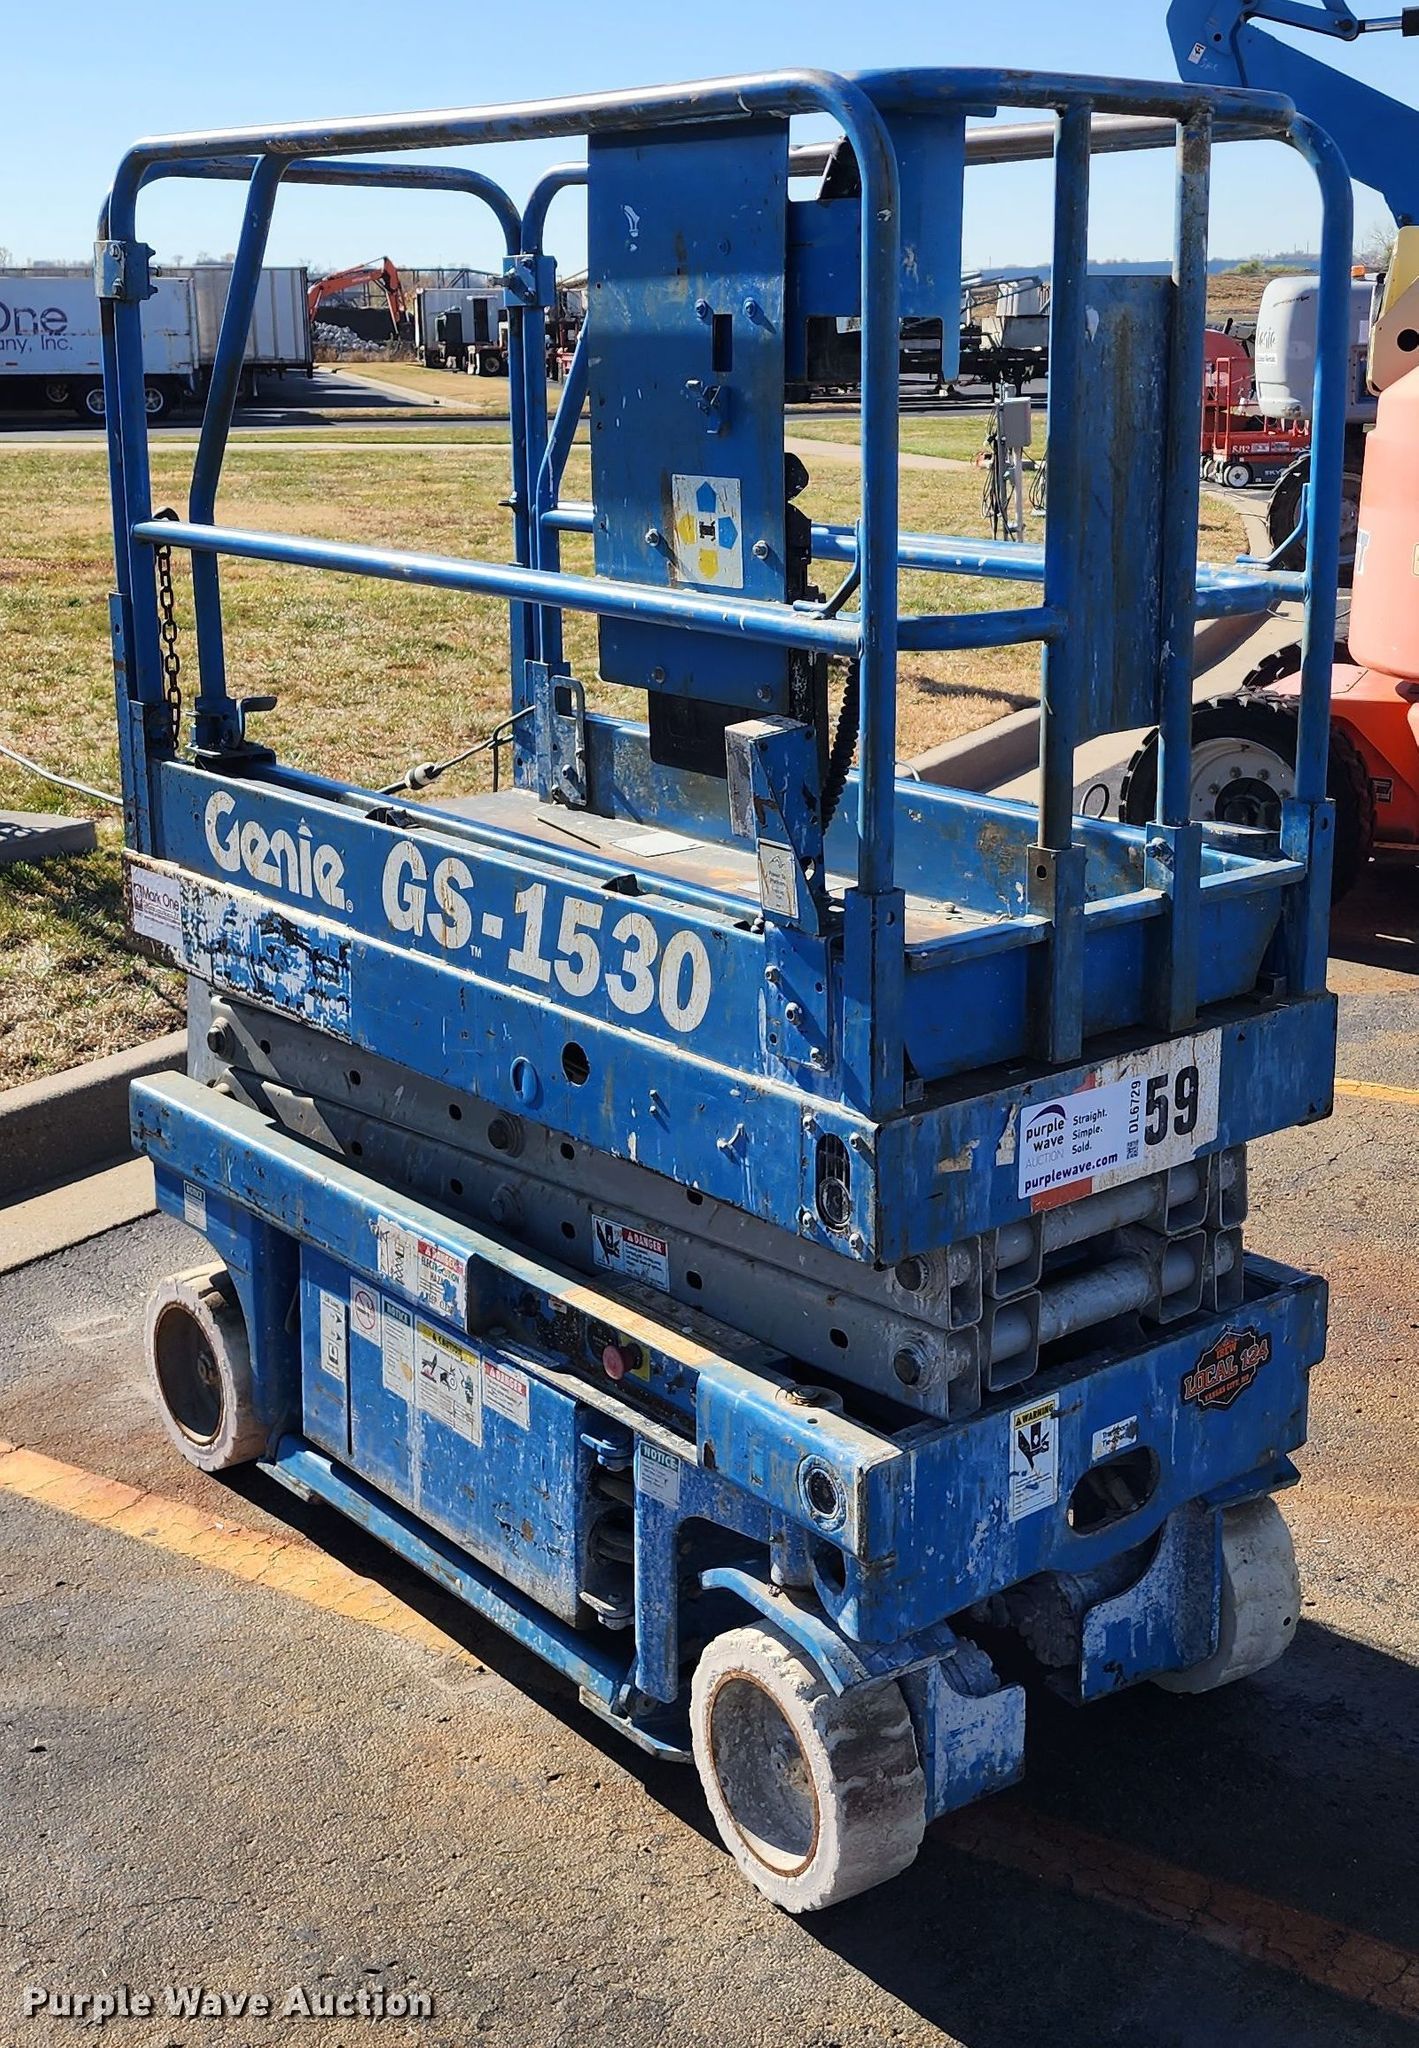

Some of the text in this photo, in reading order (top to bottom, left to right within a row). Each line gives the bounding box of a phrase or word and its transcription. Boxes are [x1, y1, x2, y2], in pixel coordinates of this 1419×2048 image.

[41, 335, 73, 351] Inc.
[162, 893, 180, 911] One
[382, 840, 712, 1033] GS-1530
[1129, 1065, 1200, 1147] DL6729 59
[1072, 1108, 1109, 1127] Straight.
[1026, 1117, 1066, 1143] purple
[1072, 1126, 1104, 1141] Simple.
[1033, 1134, 1065, 1153] wave
[1071, 1141, 1093, 1156] Sold.
[1025, 1148, 1066, 1169] AUCTION
[1024, 1152, 1119, 1194] purplewave.com
[632, 1234, 663, 1254] DANGER
[1184, 1338, 1270, 1400] LOCAL 124
[1022, 1403, 1055, 1423] WARNING
[644, 1445, 678, 1470] NOTICE
